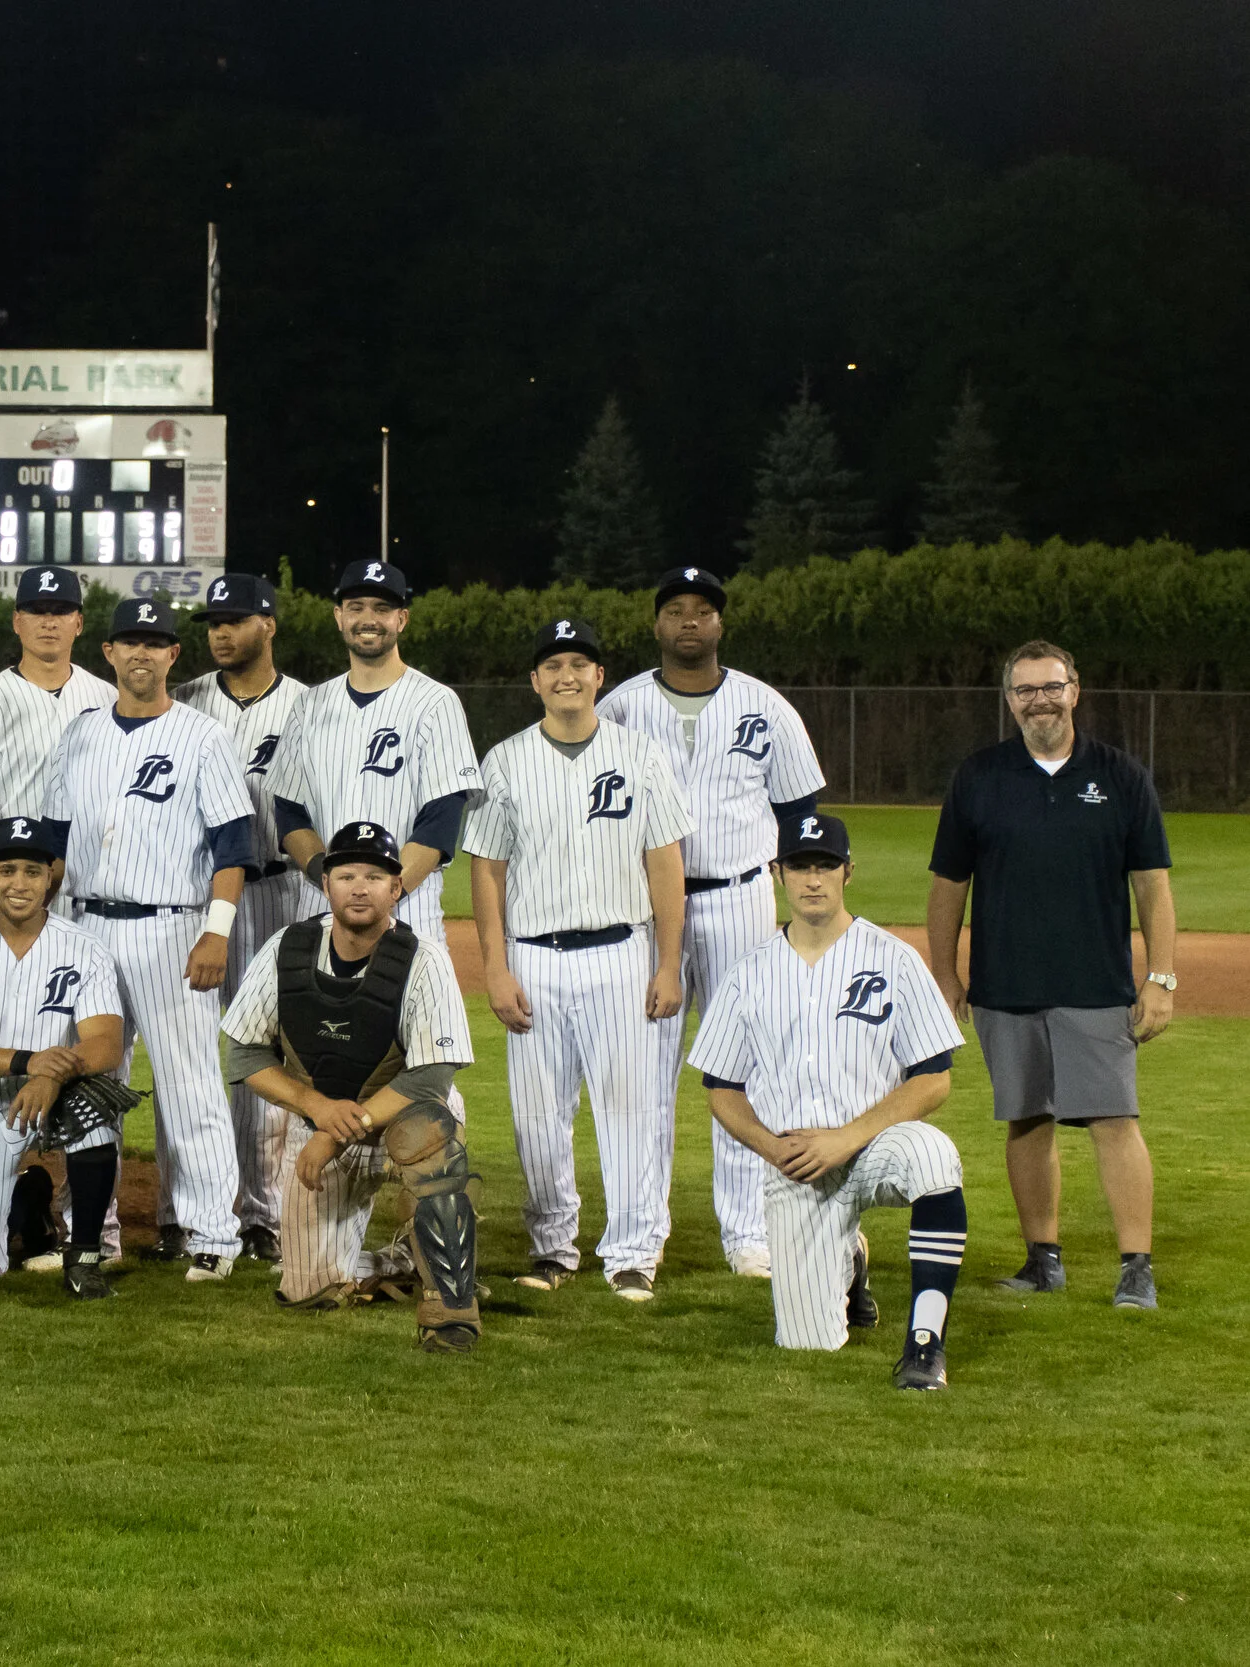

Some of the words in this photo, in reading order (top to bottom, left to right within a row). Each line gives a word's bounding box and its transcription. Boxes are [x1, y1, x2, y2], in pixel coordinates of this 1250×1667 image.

[87, 364, 184, 392] PARK
[18, 466, 52, 485] OUT
[52, 459, 74, 491] 0
[5, 494, 13, 508] 8
[168, 495, 176, 509] E
[0, 510, 18, 536] 0
[0, 537, 17, 562] 0
[172, 540, 181, 562] 1
